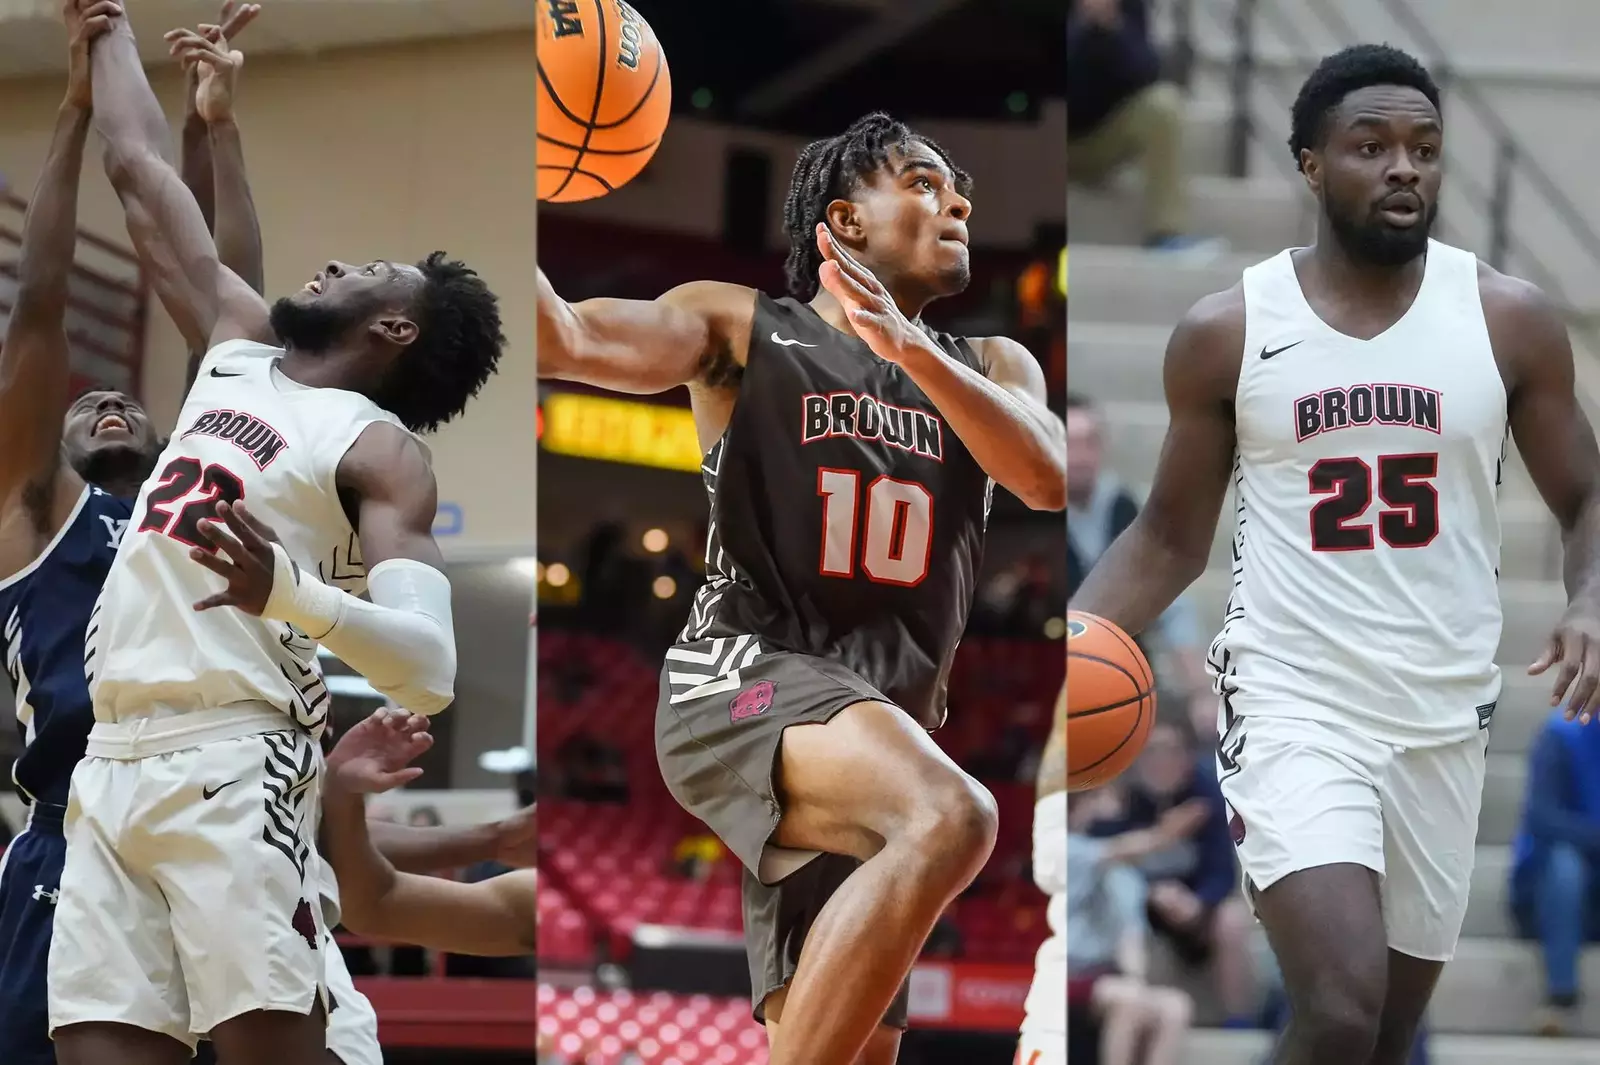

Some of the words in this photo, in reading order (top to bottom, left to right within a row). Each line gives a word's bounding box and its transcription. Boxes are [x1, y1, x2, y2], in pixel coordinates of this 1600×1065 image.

[180, 408, 288, 472] BROWN
[801, 392, 943, 464] BROWN
[1294, 382, 1442, 443] BROWN
[138, 456, 245, 556] 22
[816, 466, 933, 588] 10
[1308, 452, 1439, 551] 25
